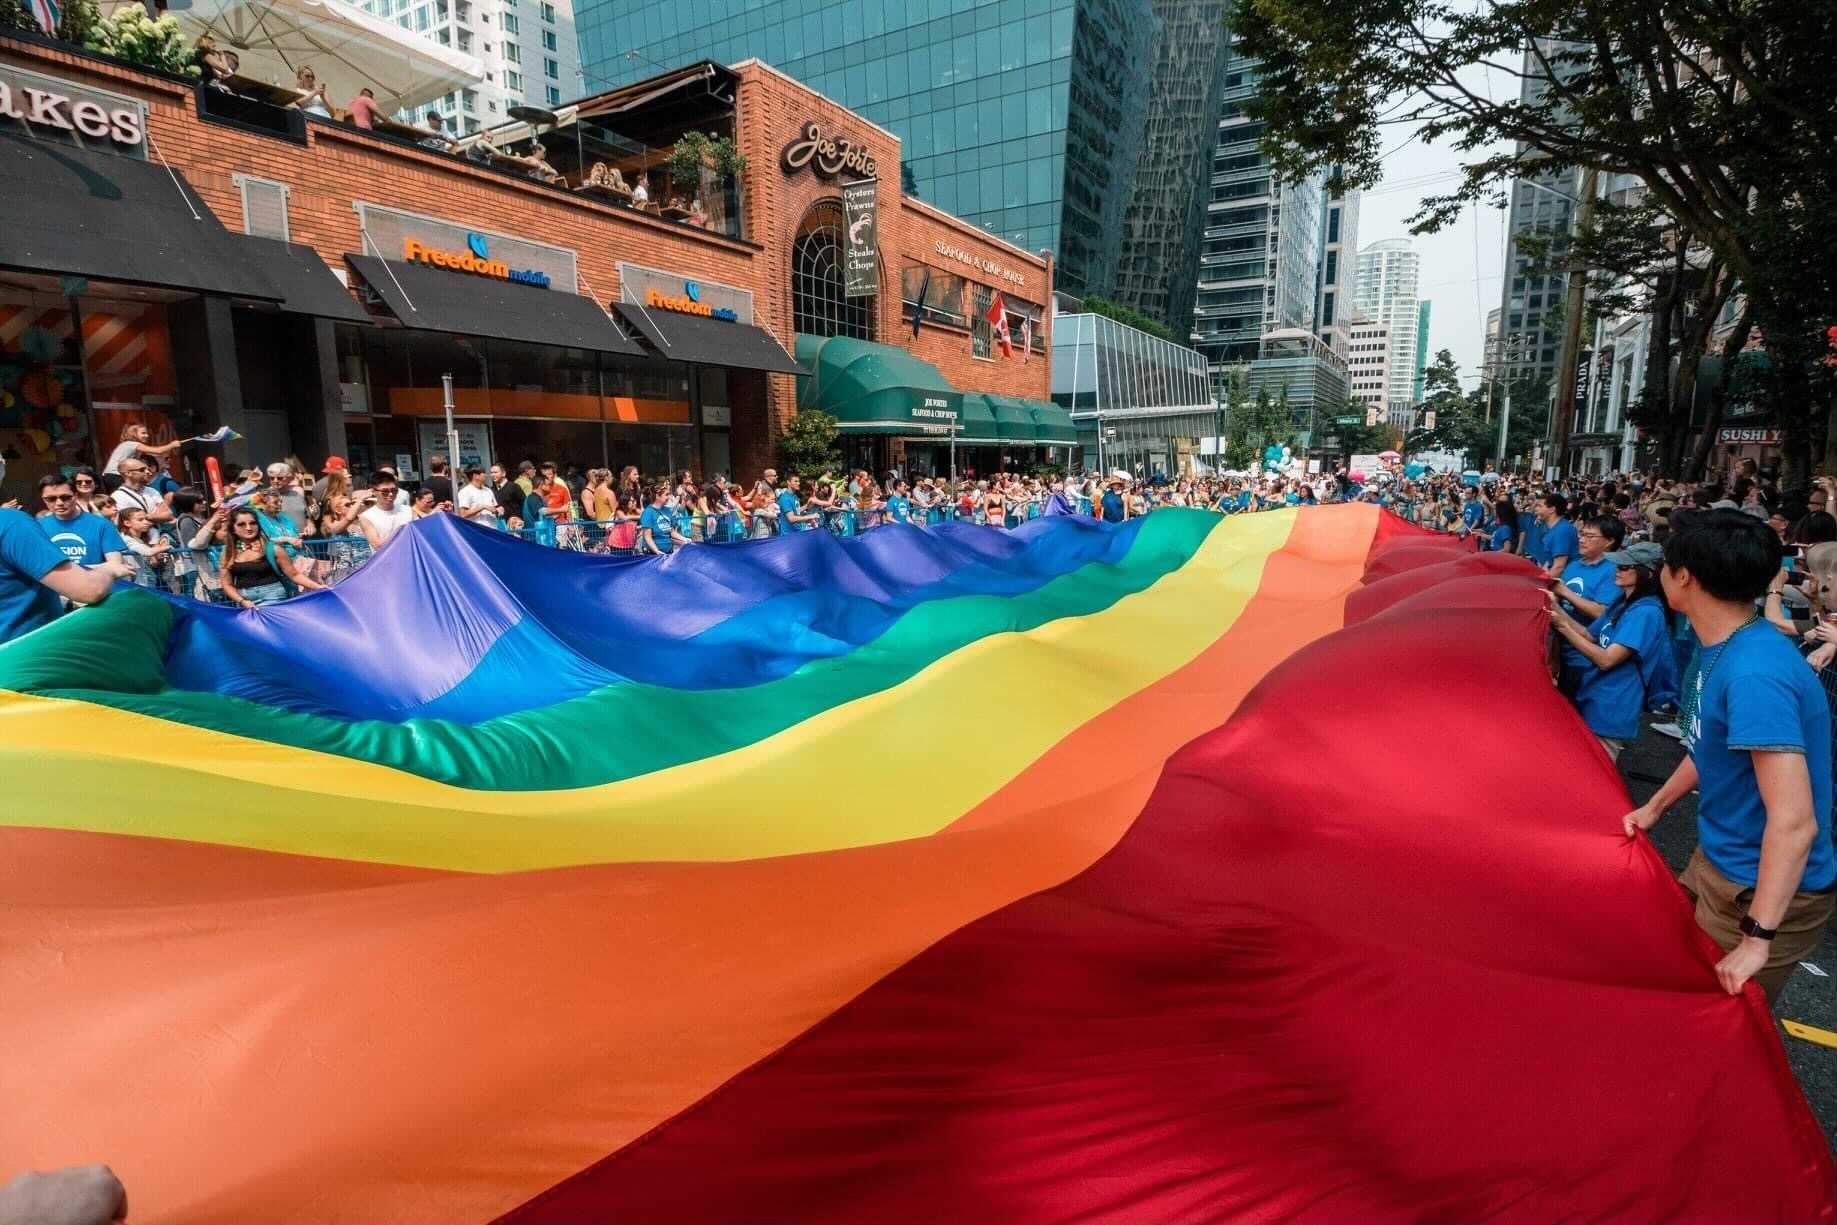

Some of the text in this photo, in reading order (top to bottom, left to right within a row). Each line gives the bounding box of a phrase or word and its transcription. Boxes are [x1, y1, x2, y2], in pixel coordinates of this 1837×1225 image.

[787, 124, 837, 168] Joe
[844, 189, 875, 201] Oysters
[845, 202, 875, 211] Prawns
[848, 245, 875, 258] Steaks
[404, 237, 552, 289] Freedom mobile
[848, 259, 875, 271] Chops
[935, 240, 972, 265] SEAFOOD
[983, 259, 1001, 275] CHOP
[1003, 268, 1024, 285] HOUSE
[646, 287, 712, 316] Freedom
[1576, 361, 1589, 399] PRADA
[1721, 429, 1767, 441] SUSHI
